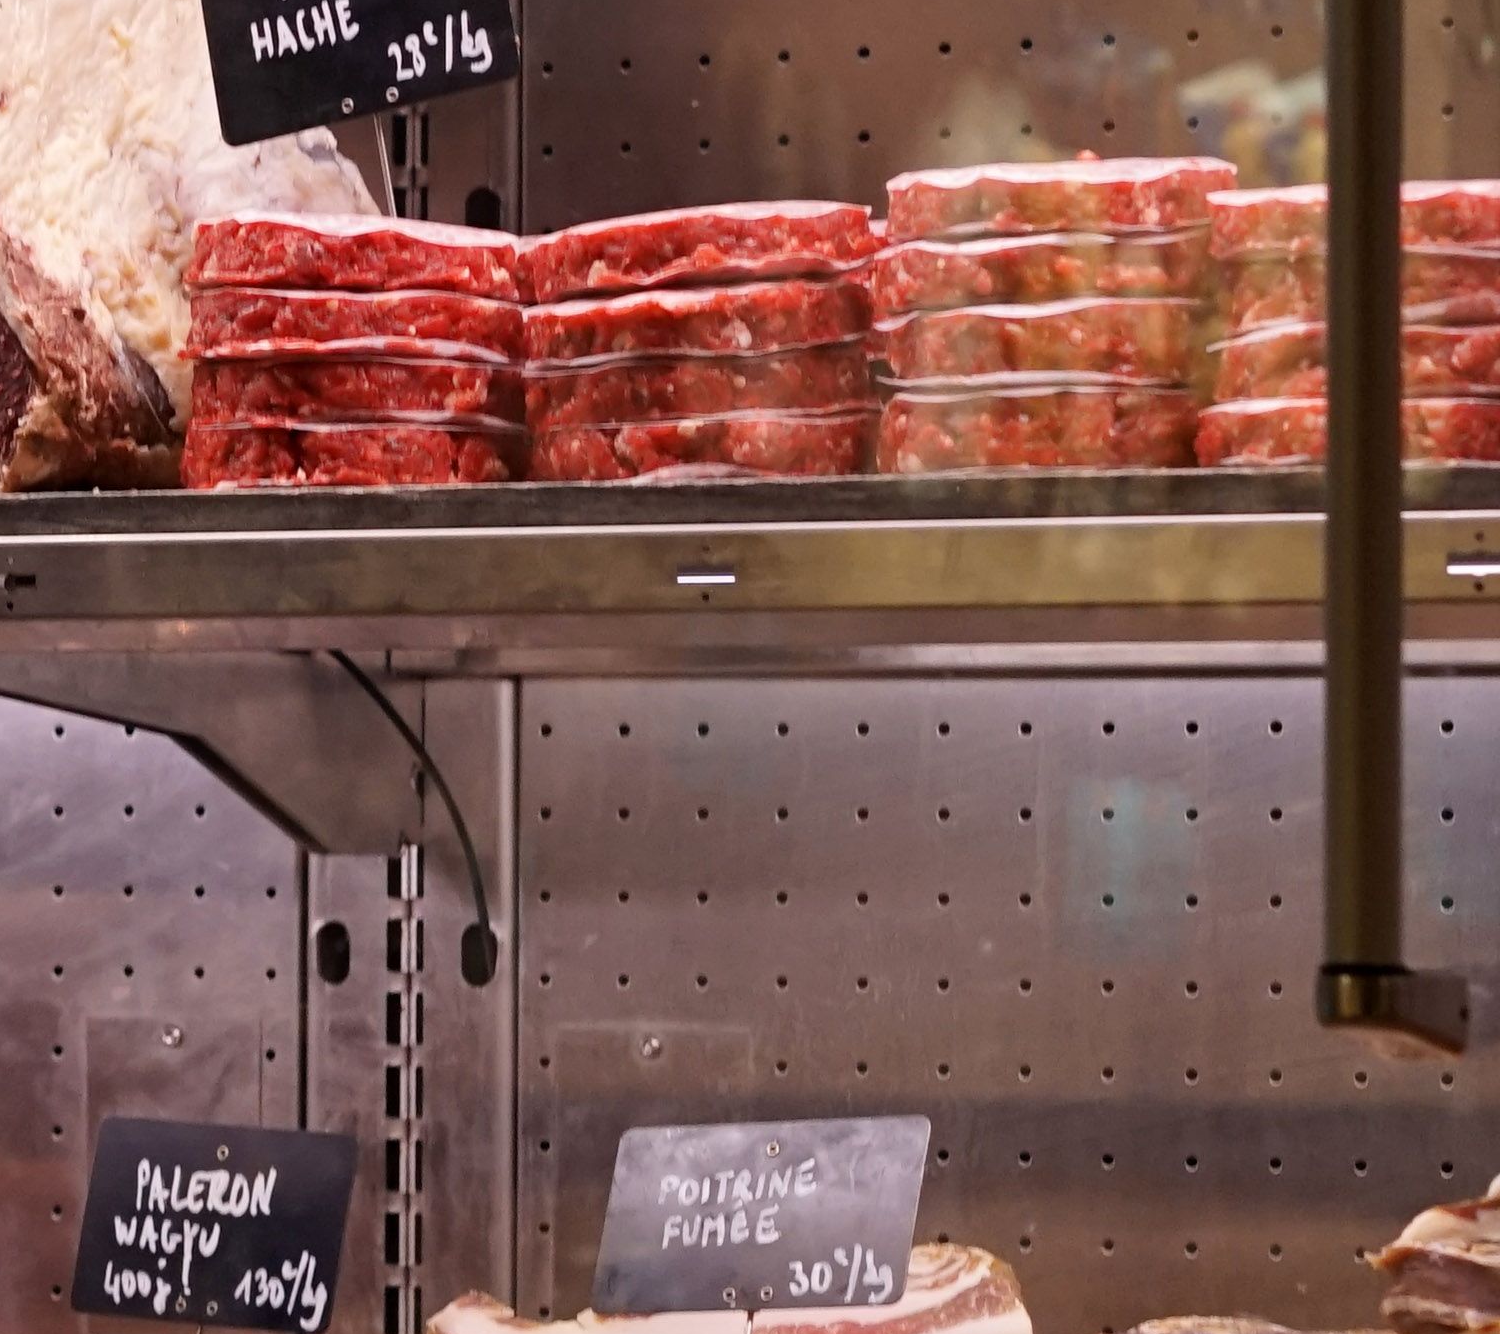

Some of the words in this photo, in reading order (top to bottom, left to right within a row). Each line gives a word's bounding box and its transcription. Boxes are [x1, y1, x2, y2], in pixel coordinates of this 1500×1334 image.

[136, 1158, 277, 1217] PALERON
[658, 1158, 818, 1206] POITRINE
[662, 1200, 781, 1250] FUMÉE
[114, 1215, 220, 1296] WAGYU
